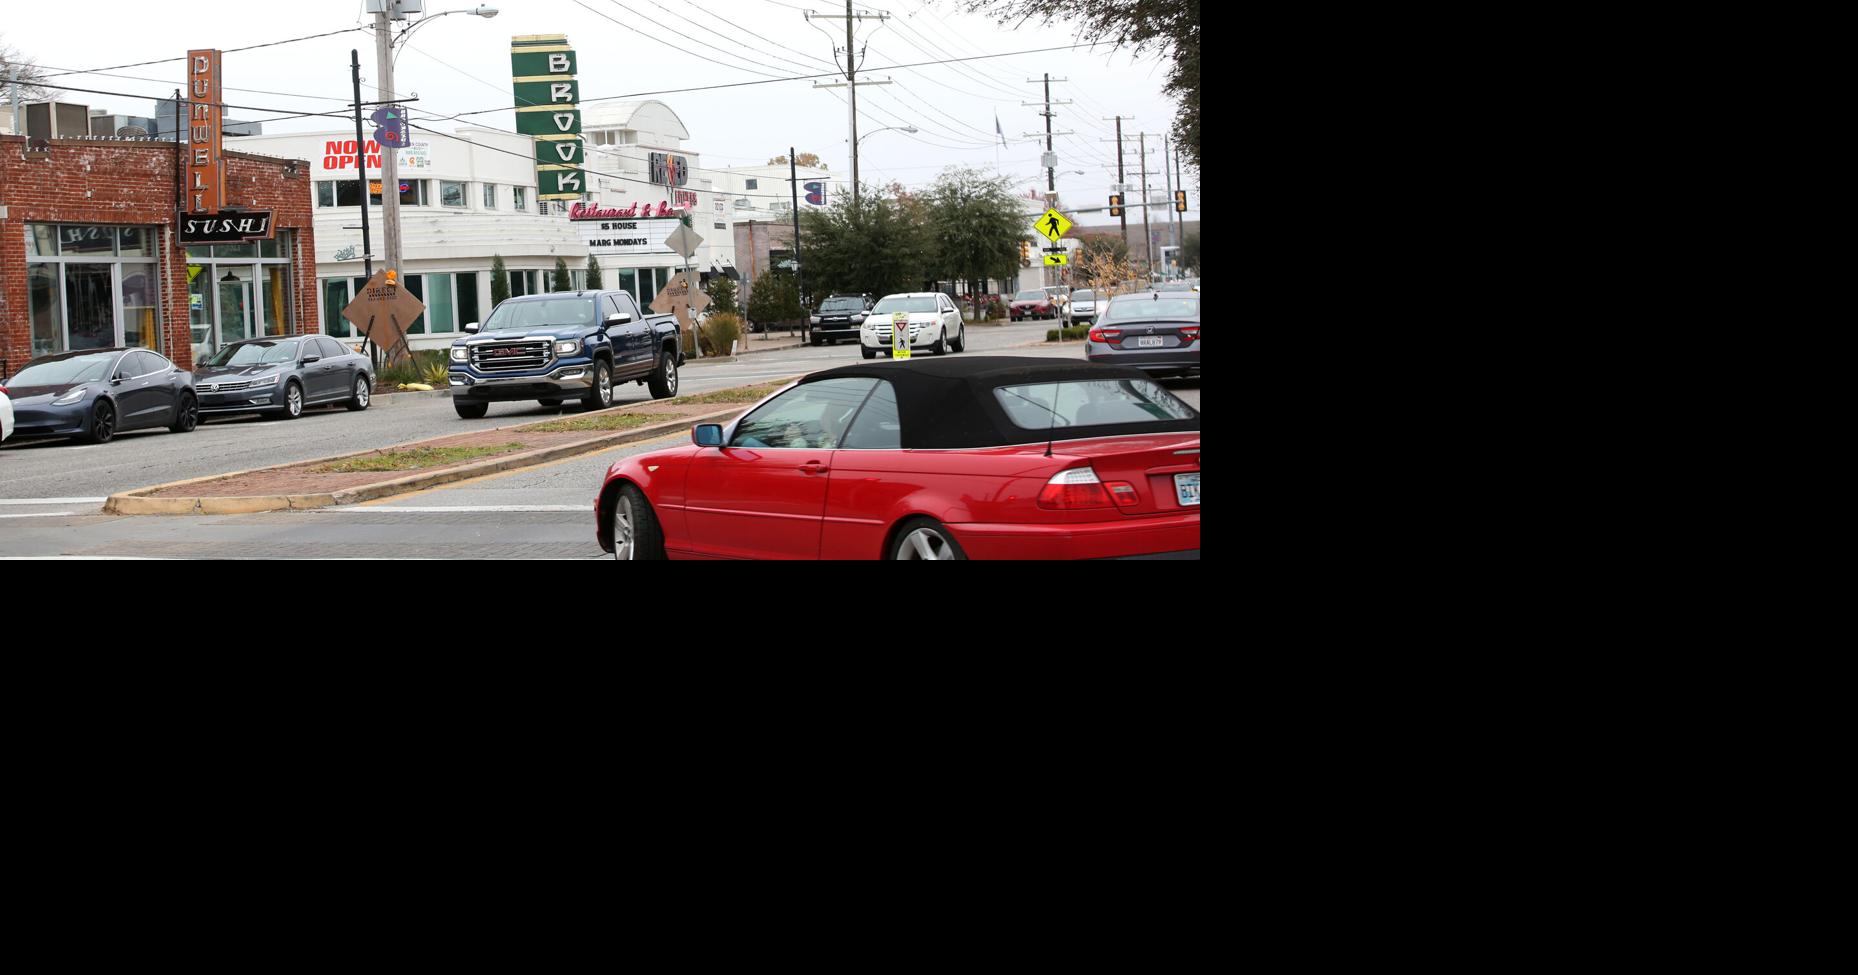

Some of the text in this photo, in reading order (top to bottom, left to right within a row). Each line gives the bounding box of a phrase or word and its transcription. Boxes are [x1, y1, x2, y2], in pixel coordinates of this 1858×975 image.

[548, 53, 580, 191] BROOK
[192, 56, 210, 213] DUNWELL
[325, 140, 381, 154] NOW
[570, 202, 637, 218] Restaurant
[641, 203, 650, 217] &
[184, 218, 267, 234] SUSHI
[589, 238, 647, 247] MARG MONDAYS
[493, 347, 526, 357] GMC
